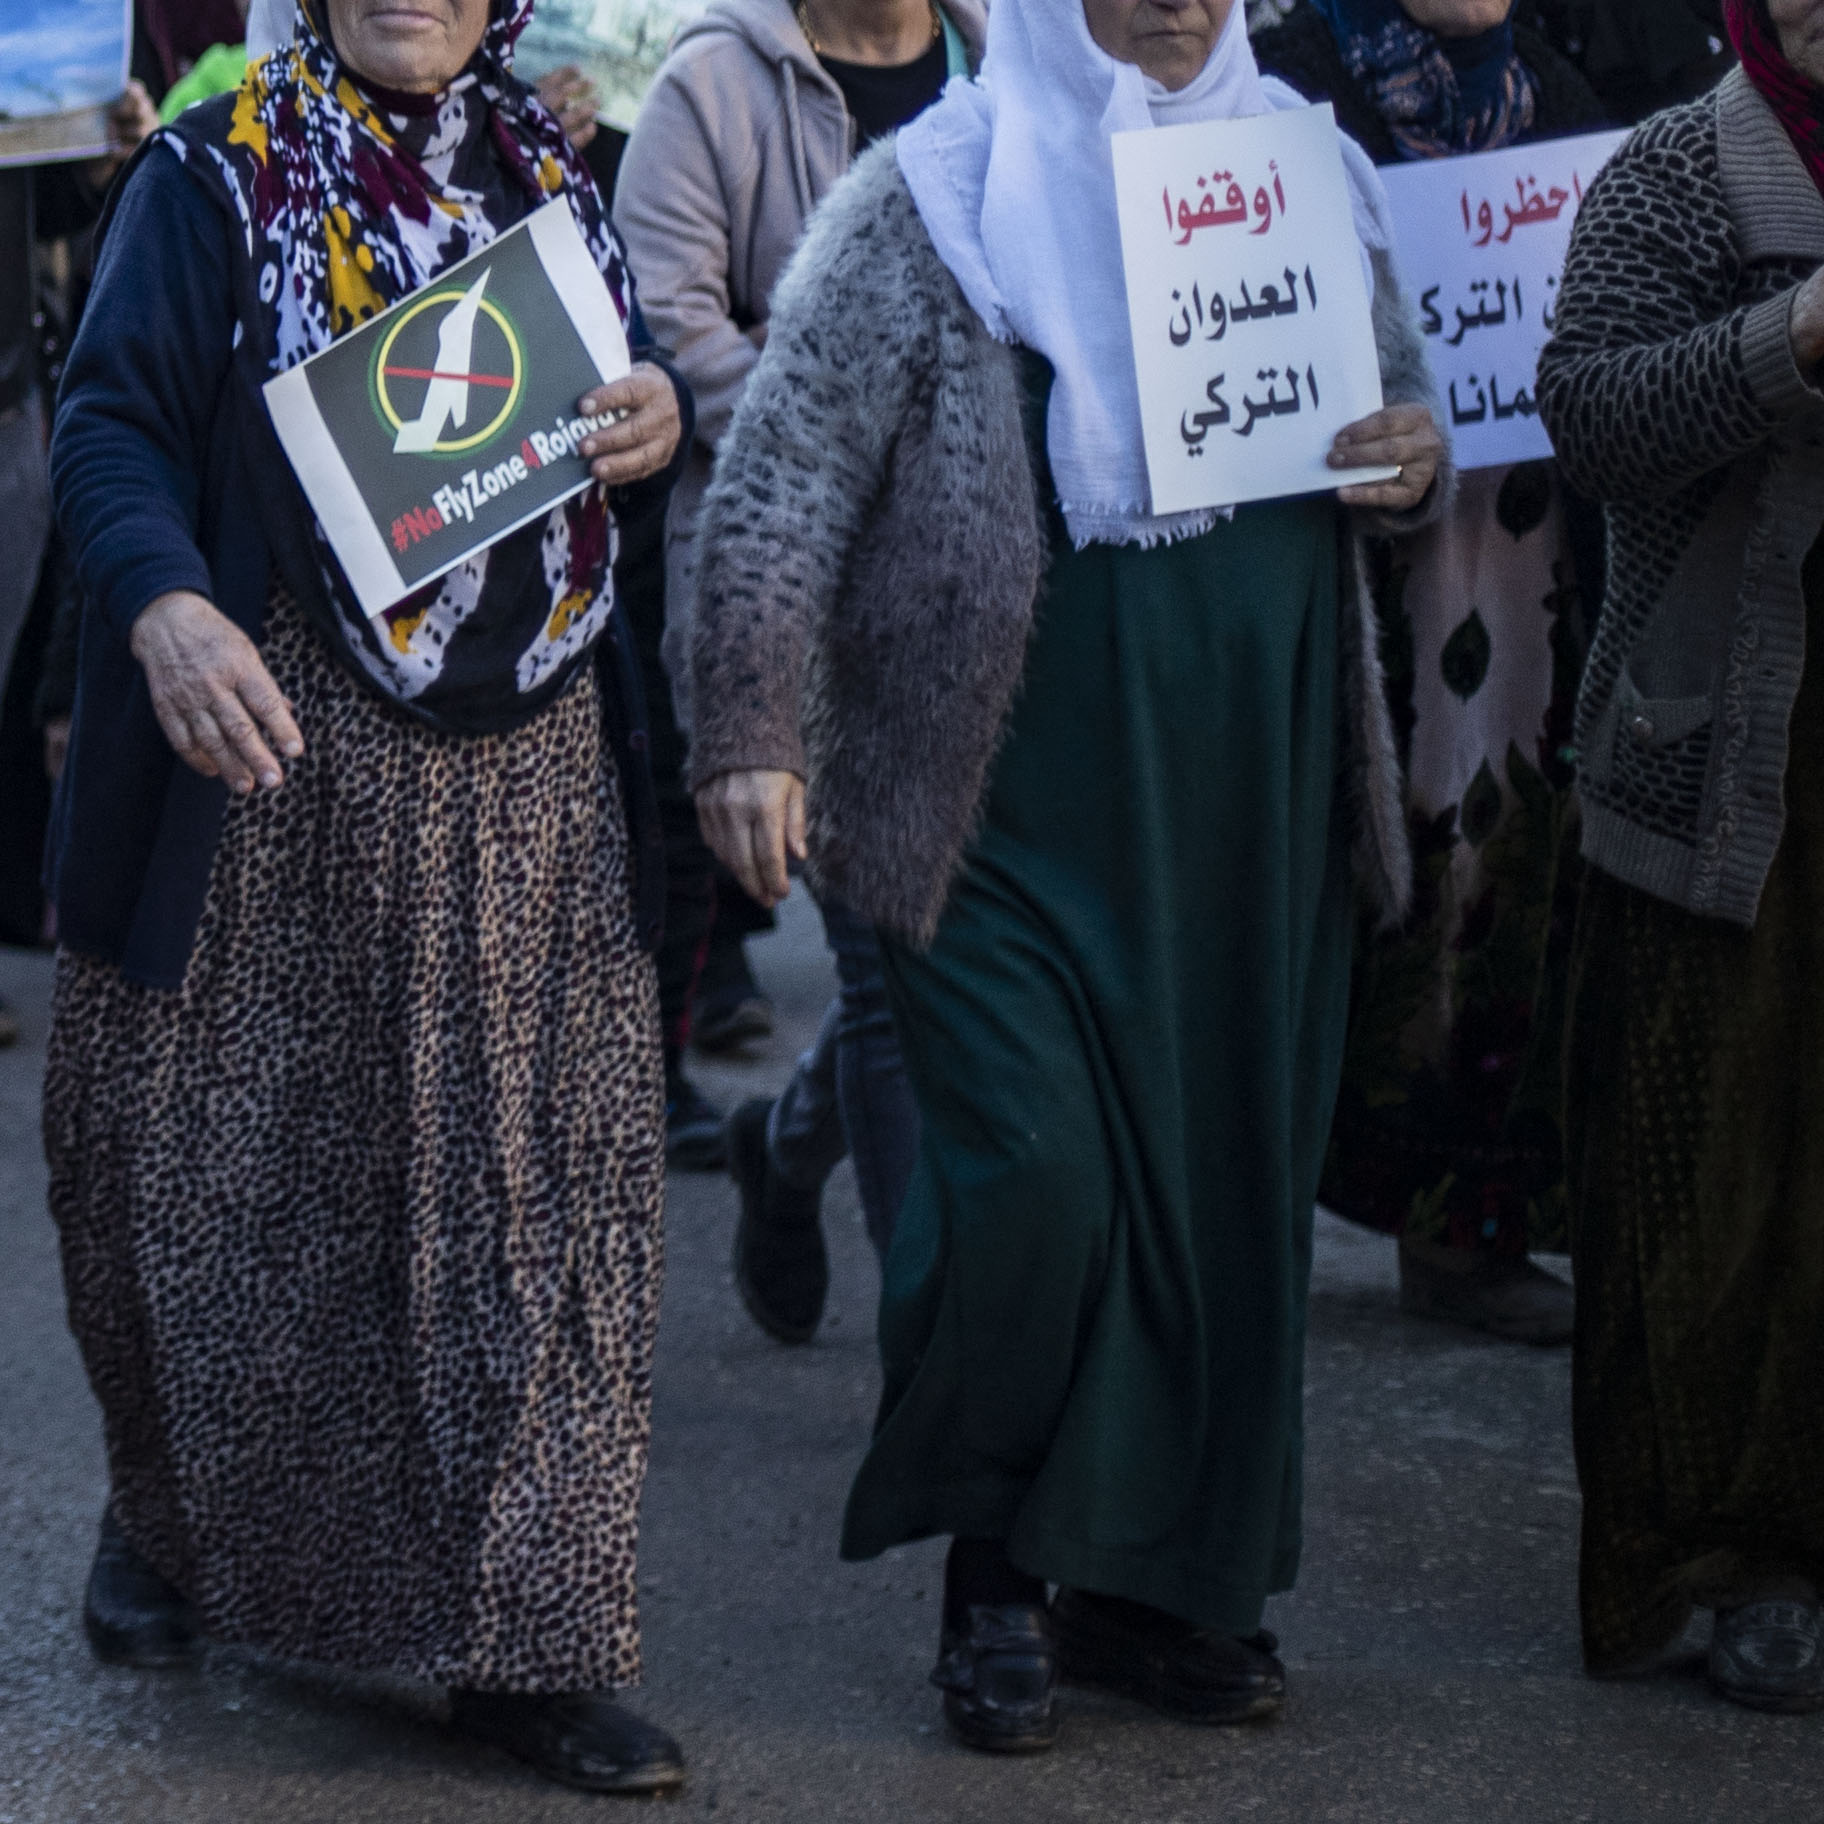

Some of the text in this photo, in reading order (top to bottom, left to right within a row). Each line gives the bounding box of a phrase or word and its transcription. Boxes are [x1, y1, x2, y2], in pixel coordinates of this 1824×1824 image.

[1163, 160, 1286, 246] أوقفوا
[1461, 170, 1582, 247] احظروا
[1169, 262, 1317, 347] العدوان
[1420, 277, 1523, 347] الترك
[1180, 362, 1319, 458] التركي
